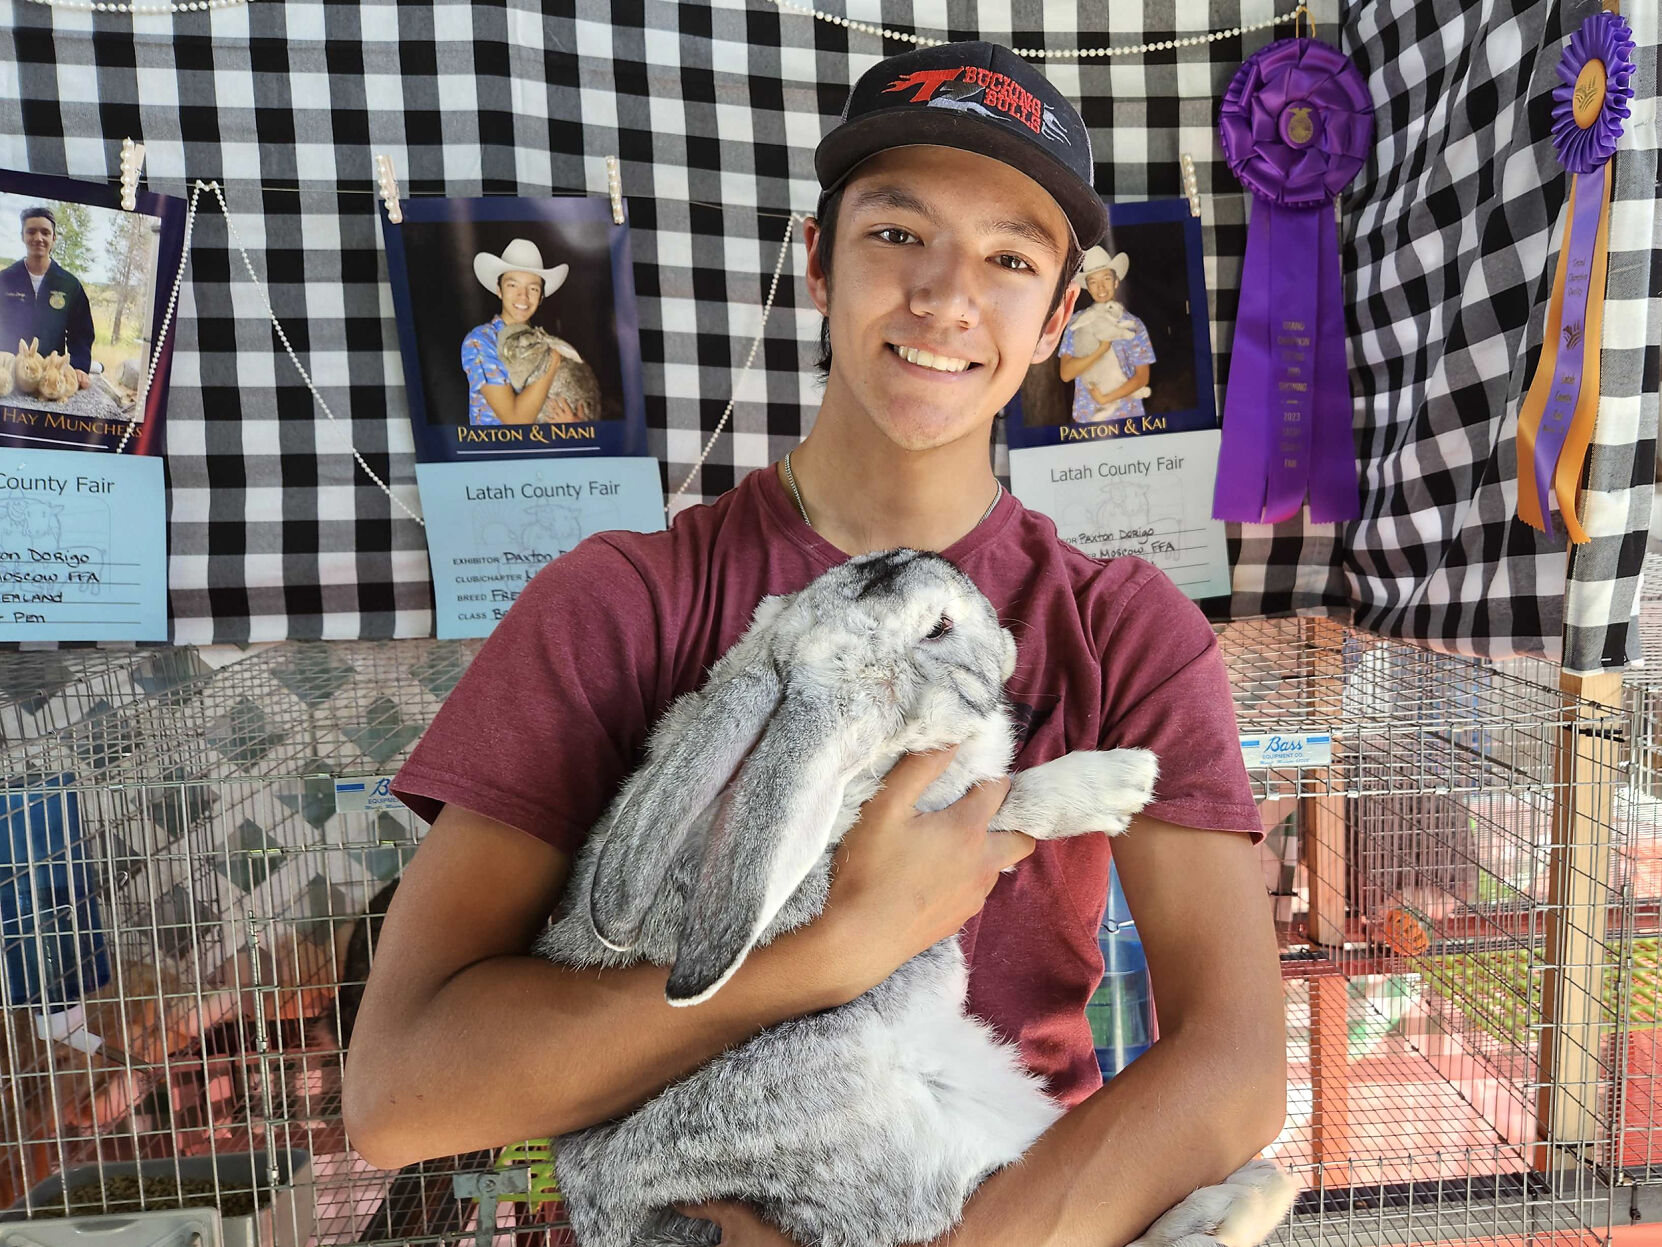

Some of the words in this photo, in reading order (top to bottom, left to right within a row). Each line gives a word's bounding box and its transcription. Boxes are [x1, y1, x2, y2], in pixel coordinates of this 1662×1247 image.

[962, 66, 1042, 117] BUCKING
[983, 88, 1041, 134] BULLS
[1283, 411, 1302, 422] 2023
[457, 426, 523, 442] PAXTON
[529, 425, 549, 443] &
[551, 424, 595, 440] NANI
[1060, 423, 1119, 441] PAXTON
[1124, 418, 1140, 435] &
[1141, 415, 1167, 431] KAI
[1050, 465, 1093, 483] Latah
[1098, 460, 1151, 477] County
[1156, 455, 1185, 471] Fair
[76, 476, 115, 494] Fair
[465, 484, 515, 501] Latah
[521, 482, 582, 500] County
[588, 480, 621, 496] Fair
[1151, 541, 1175, 553] FFA
[453, 556, 500, 565] EXHIBITOR
[457, 593, 487, 602] BREED
[457, 612, 487, 620] CLASS
[1264, 735, 1304, 753] Bass
[1262, 752, 1293, 760] EQUIPMENT
